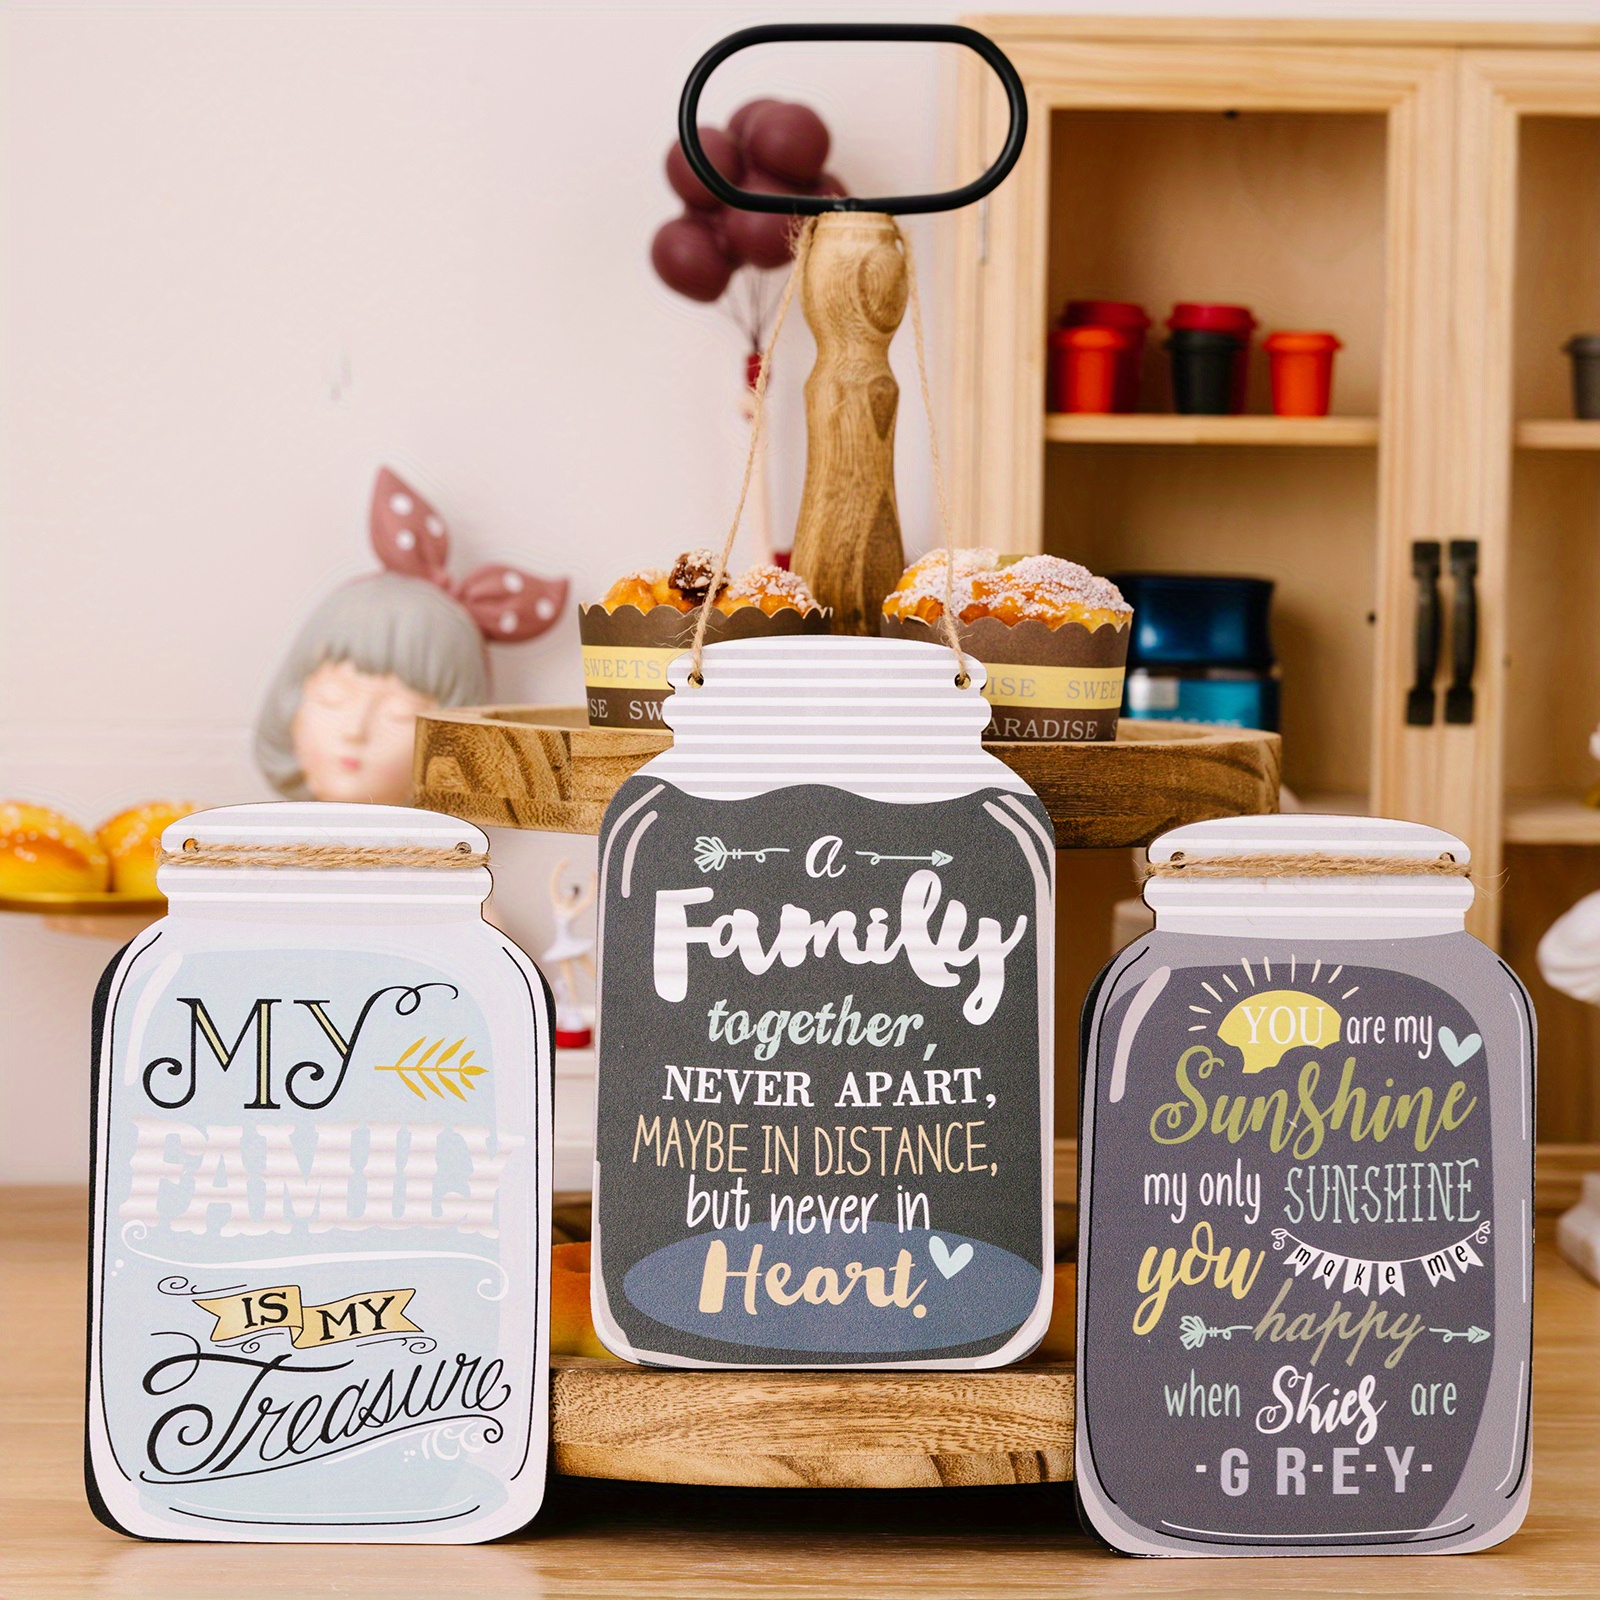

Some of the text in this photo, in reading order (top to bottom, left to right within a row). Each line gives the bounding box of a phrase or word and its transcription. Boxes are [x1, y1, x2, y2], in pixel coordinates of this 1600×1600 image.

[584, 657, 661, 679] SWEETS
[804, 834, 847, 879] a
[652, 868, 1029, 1027] Family
[142, 982, 459, 1111] MY
[706, 993, 938, 1062] together,
[1239, 1005, 1433, 1061] YOU are my
[661, 1064, 998, 1110] NEVER APART,
[117, 1114, 526, 1239] FAMILY
[631, 1113, 999, 1178] MAYBE IN DISTANCE,
[685, 1173, 931, 1236] but never in
[1143, 1157, 1481, 1225] my only SUNSHINE
[697, 1238, 929, 1320] Heart.
[1132, 1220, 1469, 1336] you make me
[241, 1291, 396, 1343] IS MY
[1252, 1277, 1426, 1370] happy
[141, 1331, 512, 1476] Treasure
[1163, 1364, 1458, 1446] when Skies are
